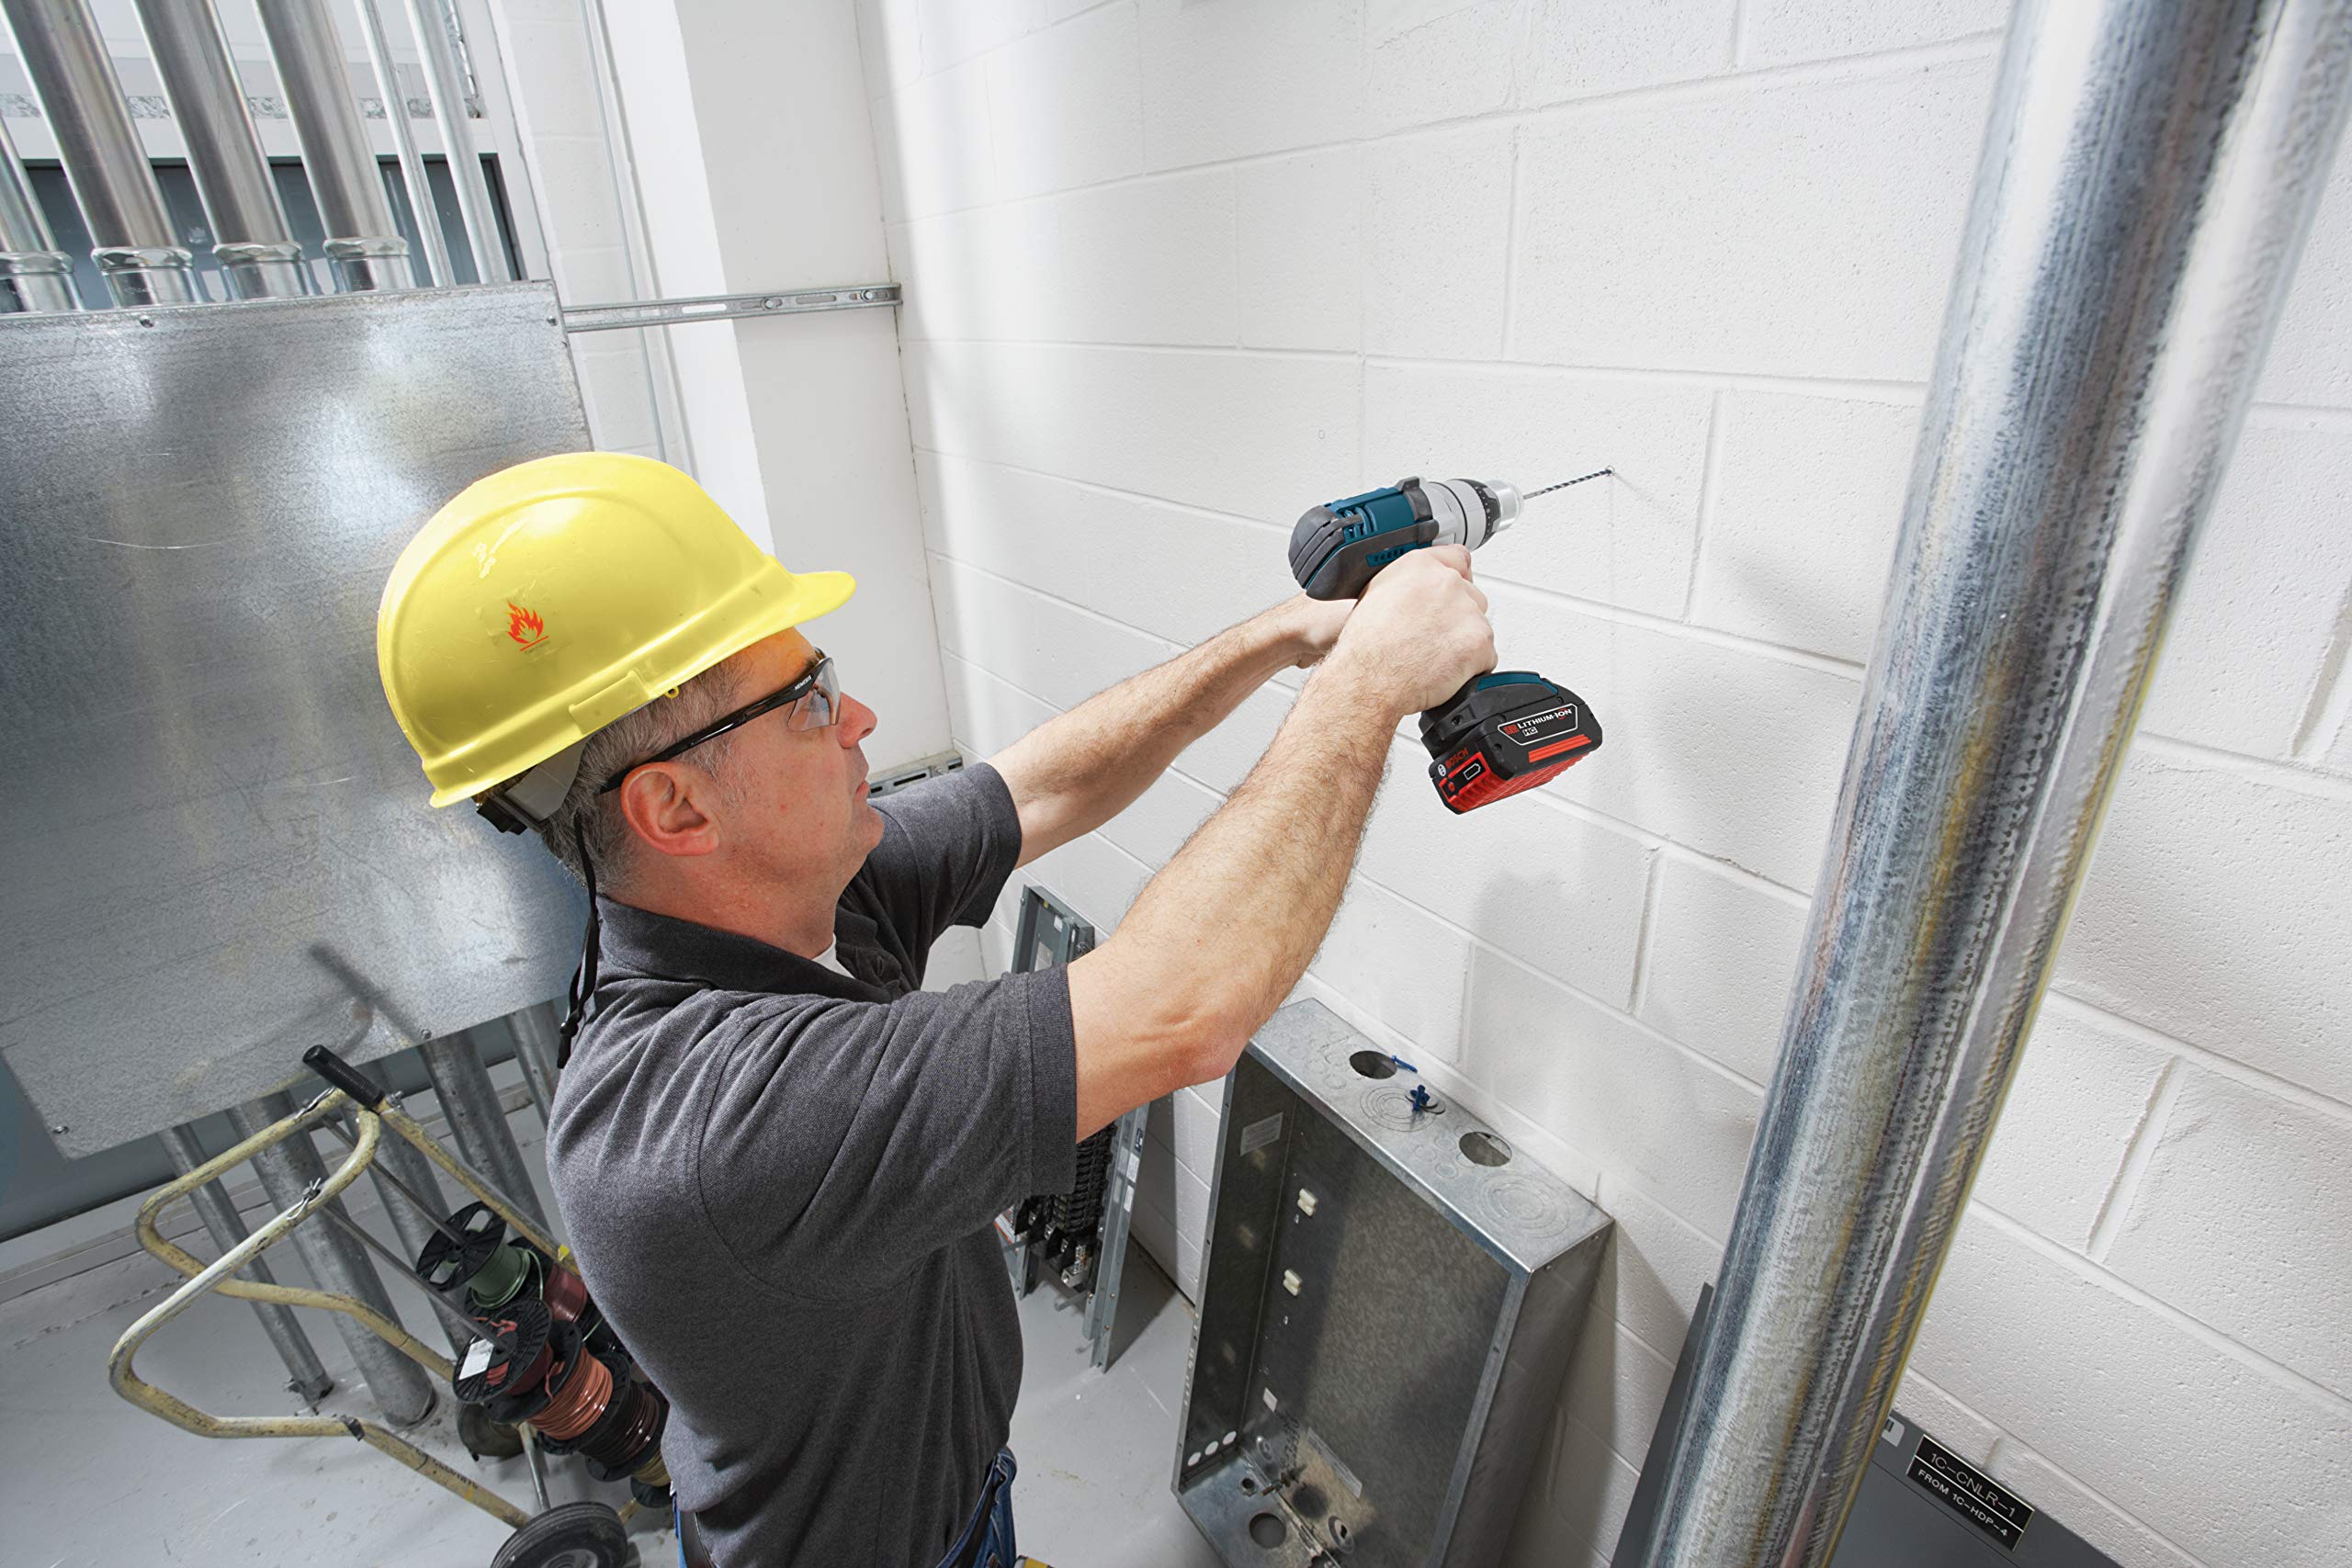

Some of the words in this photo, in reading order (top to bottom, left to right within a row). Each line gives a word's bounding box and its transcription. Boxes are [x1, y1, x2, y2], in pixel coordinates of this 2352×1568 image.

[1517, 708, 1572, 729] LITHIUM-ION
[1445, 748, 1468, 769] BOSCH
[1917, 1469, 1949, 1495] FROM
[1952, 1494, 2007, 1537] 1C-HDP-4
[1931, 1453, 2016, 1517] 1C-CNLR-1
